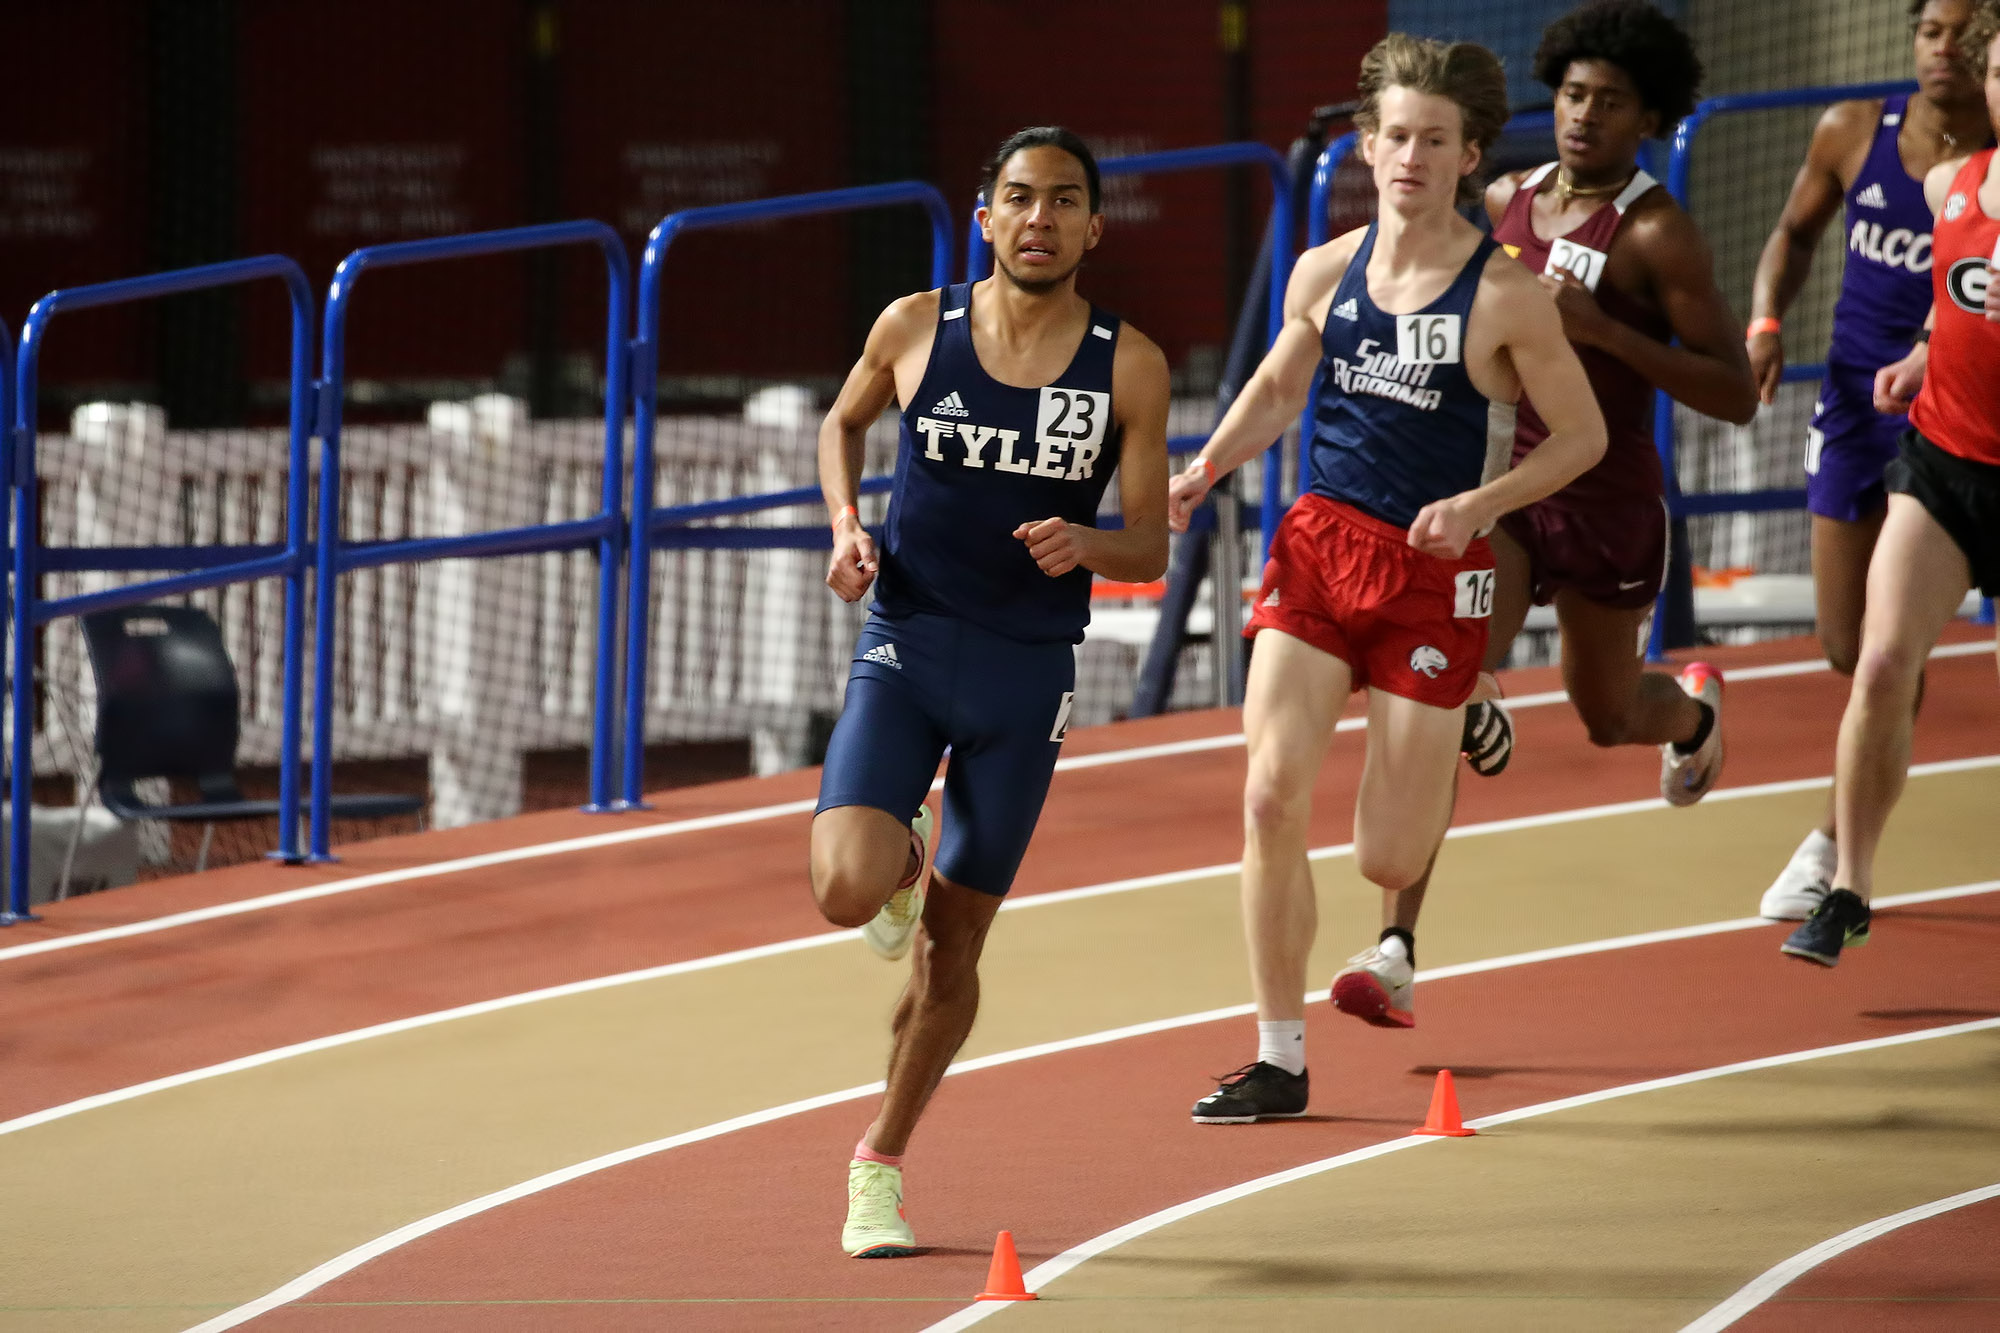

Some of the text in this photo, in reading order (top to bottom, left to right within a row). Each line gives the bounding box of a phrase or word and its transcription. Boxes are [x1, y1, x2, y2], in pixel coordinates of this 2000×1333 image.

[1407, 318, 1447, 361] 16
[931, 405, 970, 418] adidas
[1046, 390, 1096, 441] 23
[916, 416, 1102, 481] TYLER
[1467, 571, 1493, 615] 16
[862, 652, 903, 670] adidas
